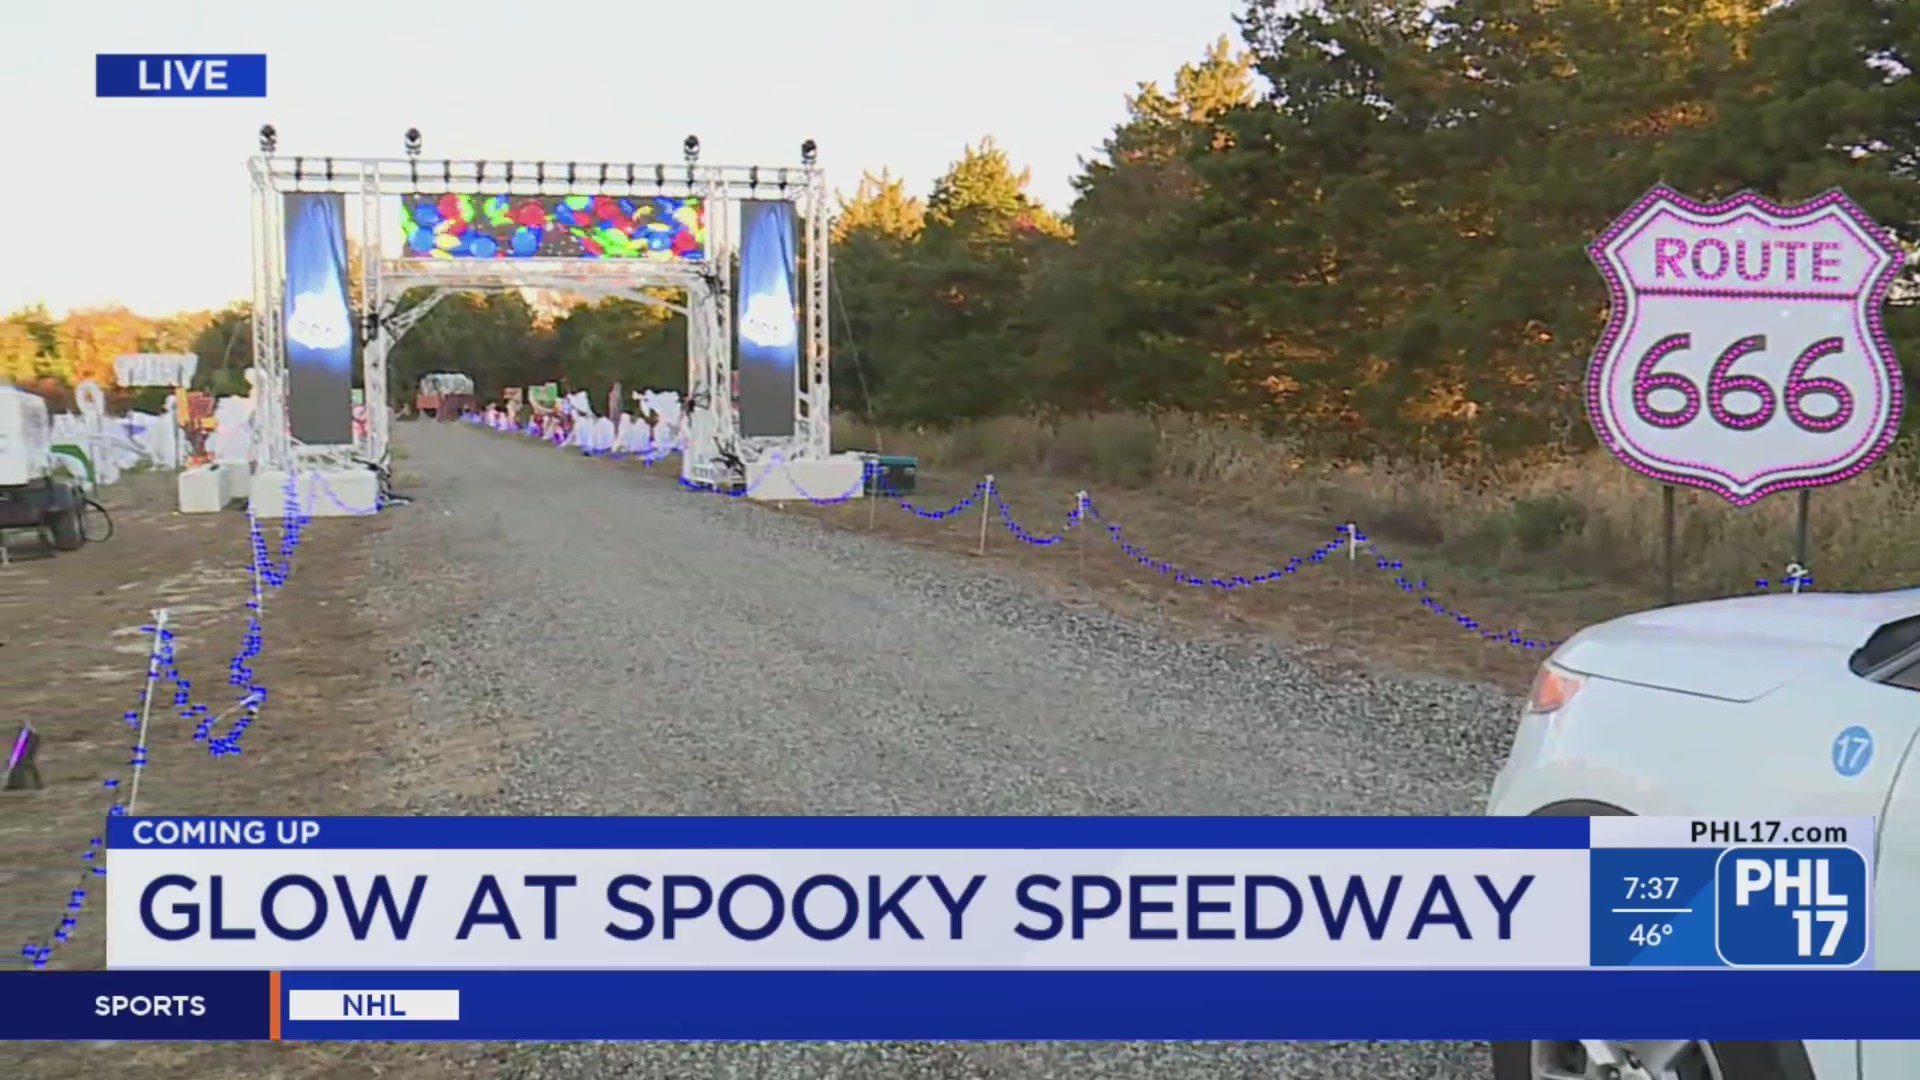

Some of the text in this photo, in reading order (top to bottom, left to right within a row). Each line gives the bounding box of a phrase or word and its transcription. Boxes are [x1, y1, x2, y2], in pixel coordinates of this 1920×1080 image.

[1654, 236, 1842, 283] ROUTE
[1632, 331, 1855, 434] 666
[1837, 734, 1870, 769] 17
